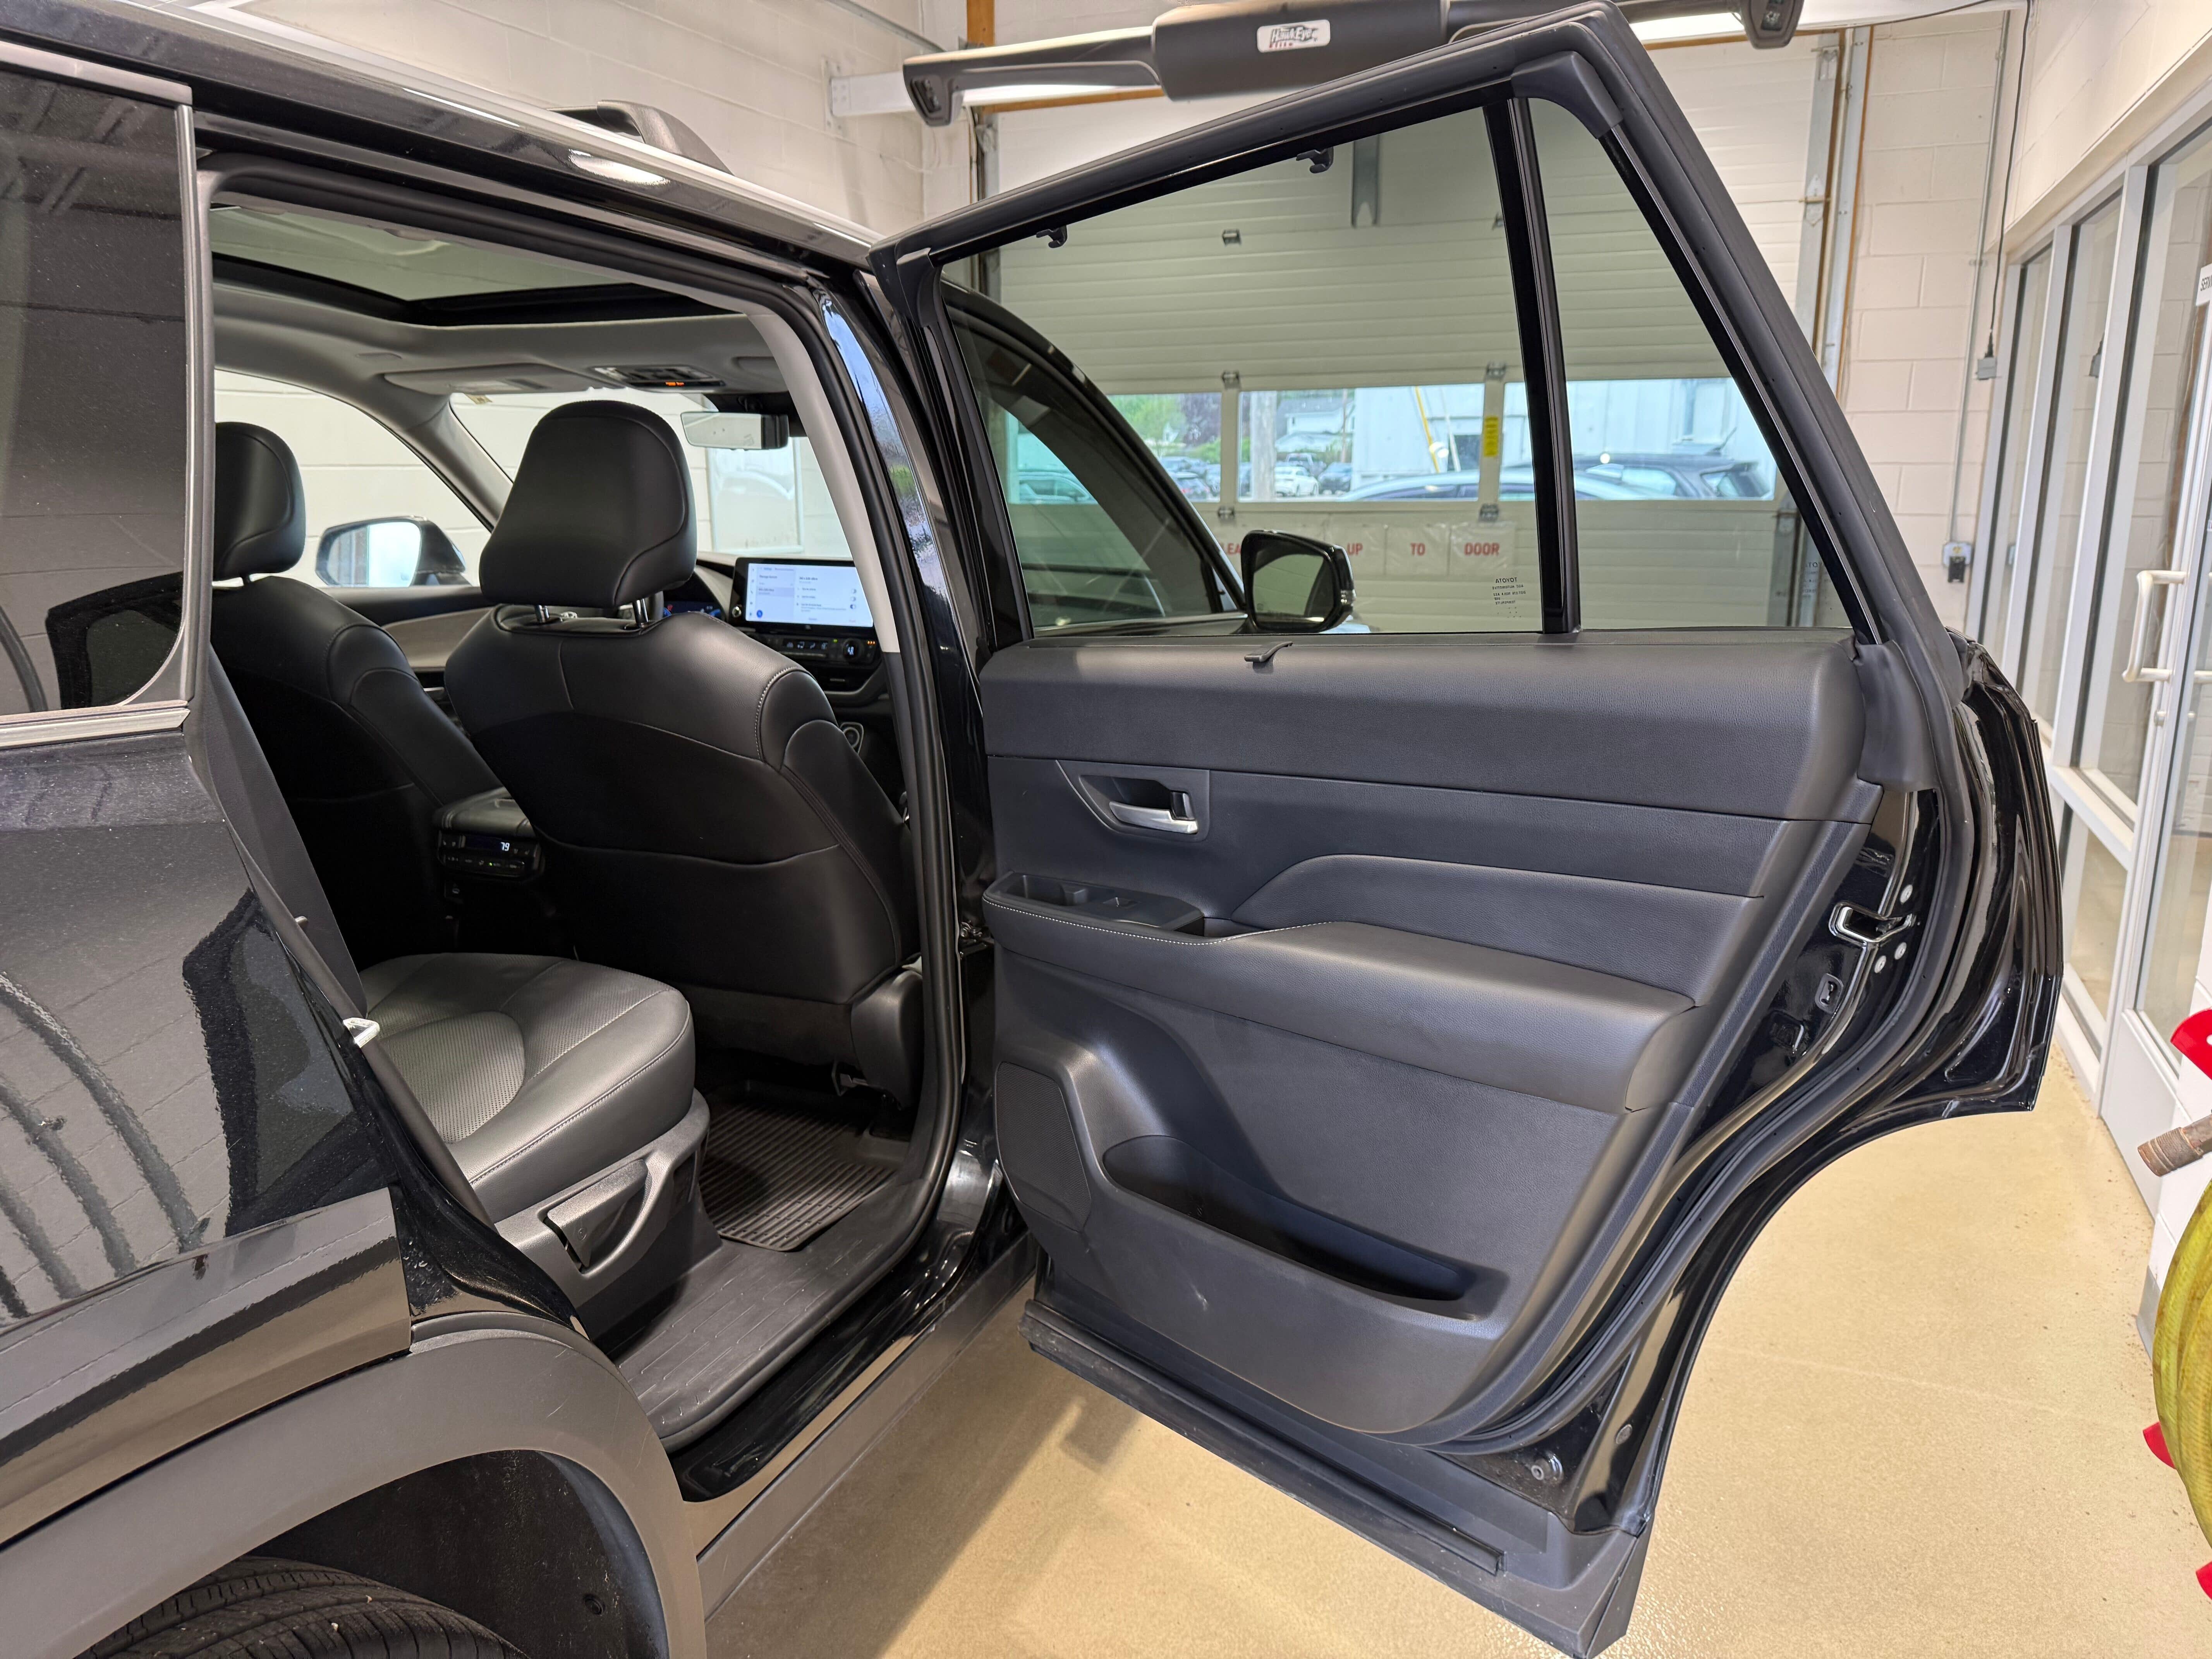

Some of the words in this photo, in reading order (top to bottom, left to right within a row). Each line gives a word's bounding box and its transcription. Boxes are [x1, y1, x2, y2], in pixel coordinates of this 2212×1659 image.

[1347, 543, 1363, 555] UP
[1410, 543, 1425, 556] TO
[1464, 543, 1500, 556] DOOR
[500, 842, 510, 851] 79
